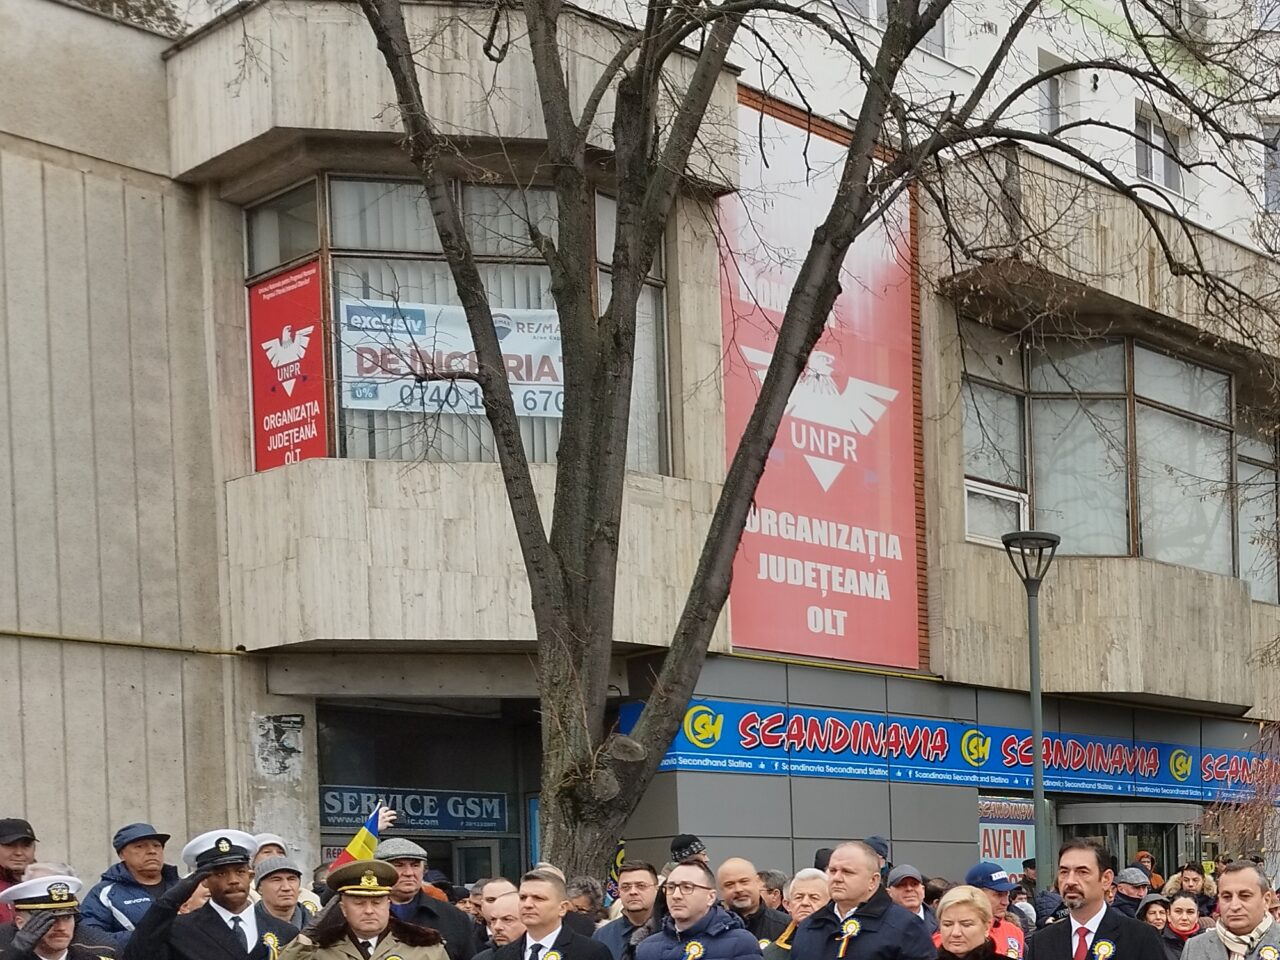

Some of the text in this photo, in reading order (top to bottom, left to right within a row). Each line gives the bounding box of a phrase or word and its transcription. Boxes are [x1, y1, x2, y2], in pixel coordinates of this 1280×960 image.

[350, 313, 424, 335] exclusiv
[277, 362, 301, 382] UNPR
[356, 346, 401, 377] DE
[400, 384, 460, 409] 0740
[263, 400, 320, 432] ORGANIZAȚIA
[267, 420, 318, 452] JUDEȚEANĂ
[790, 422, 858, 463] UNPR
[284, 449, 302, 465] OLT
[745, 504, 903, 563] ORGANIZAȚIA
[757, 552, 891, 601] JUDEȚEANĂ
[806, 605, 848, 637] OLT
[738, 711, 949, 762] SCANDINAVIA
[1001, 734, 1160, 777] SCANDINAVIA
[678, 756, 727, 767] Secondhand
[781, 762, 825, 773] Scandinavia
[825, 764, 868, 775] Secondhand
[915, 770, 952, 781] Scandinavia
[323, 791, 501, 819] SERVICE GSM
[982, 828, 1027, 859] AVEM
